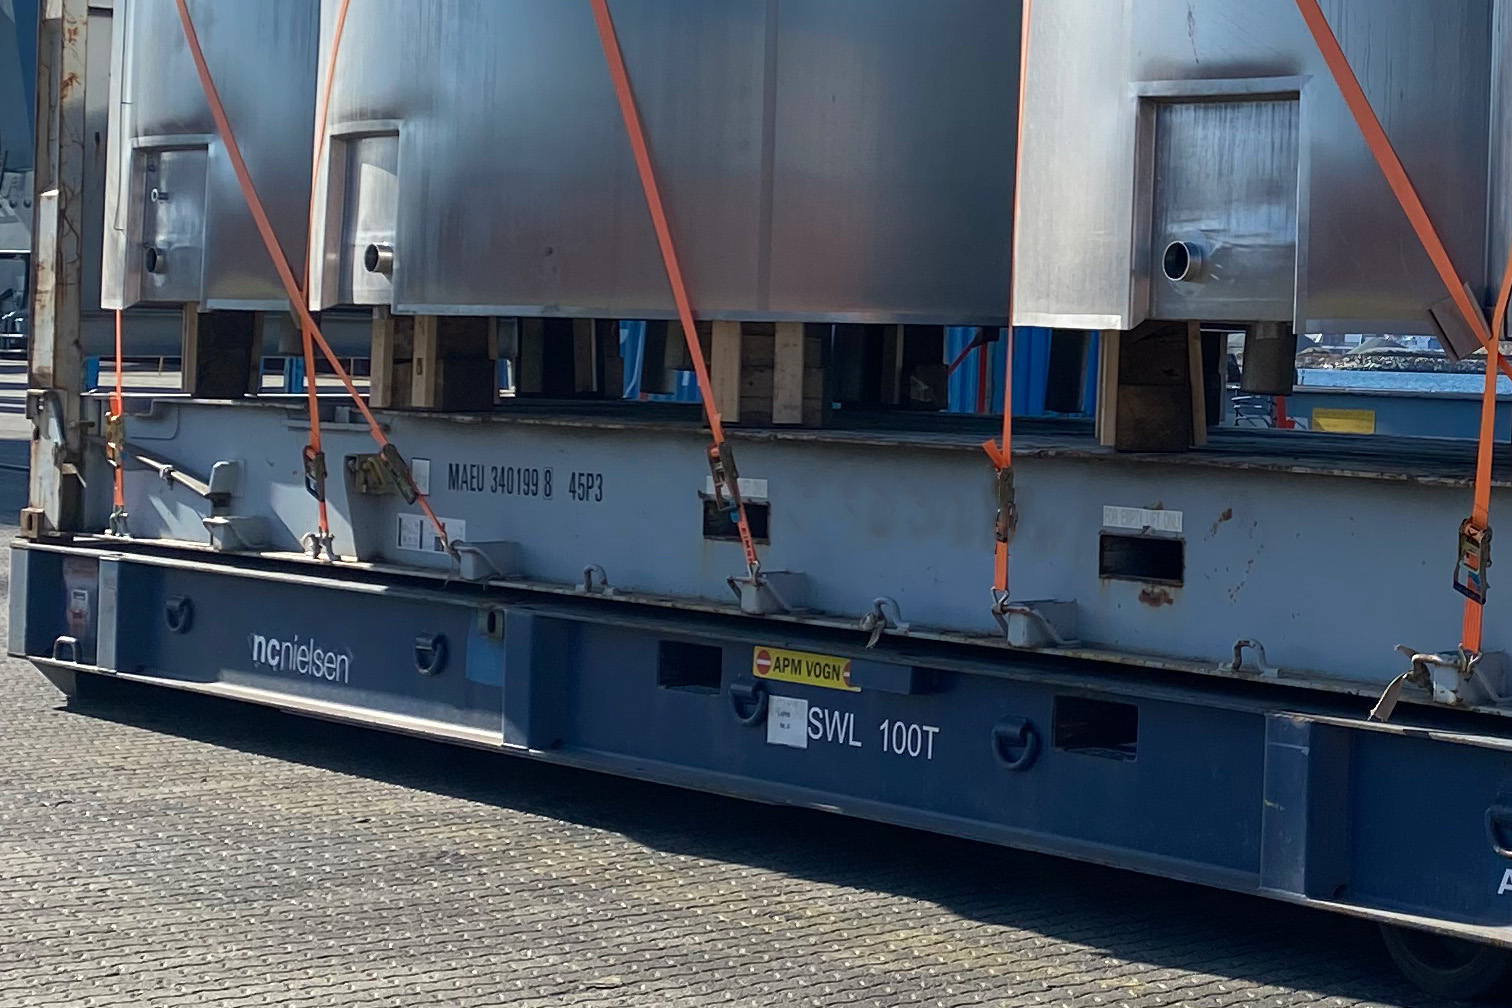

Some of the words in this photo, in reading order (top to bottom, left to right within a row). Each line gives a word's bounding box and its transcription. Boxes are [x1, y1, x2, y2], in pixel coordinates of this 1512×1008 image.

[448, 462, 485, 492] MAEU
[490, 466, 539, 497] 340199
[543, 469, 553, 498] 8
[568, 472, 604, 502] 45P3
[253, 634, 349, 684] ncnielsen
[773, 656, 802, 676] APM
[806, 661, 841, 682] VOGN
[808, 706, 862, 747] SWL
[879, 719, 940, 760] 100T
